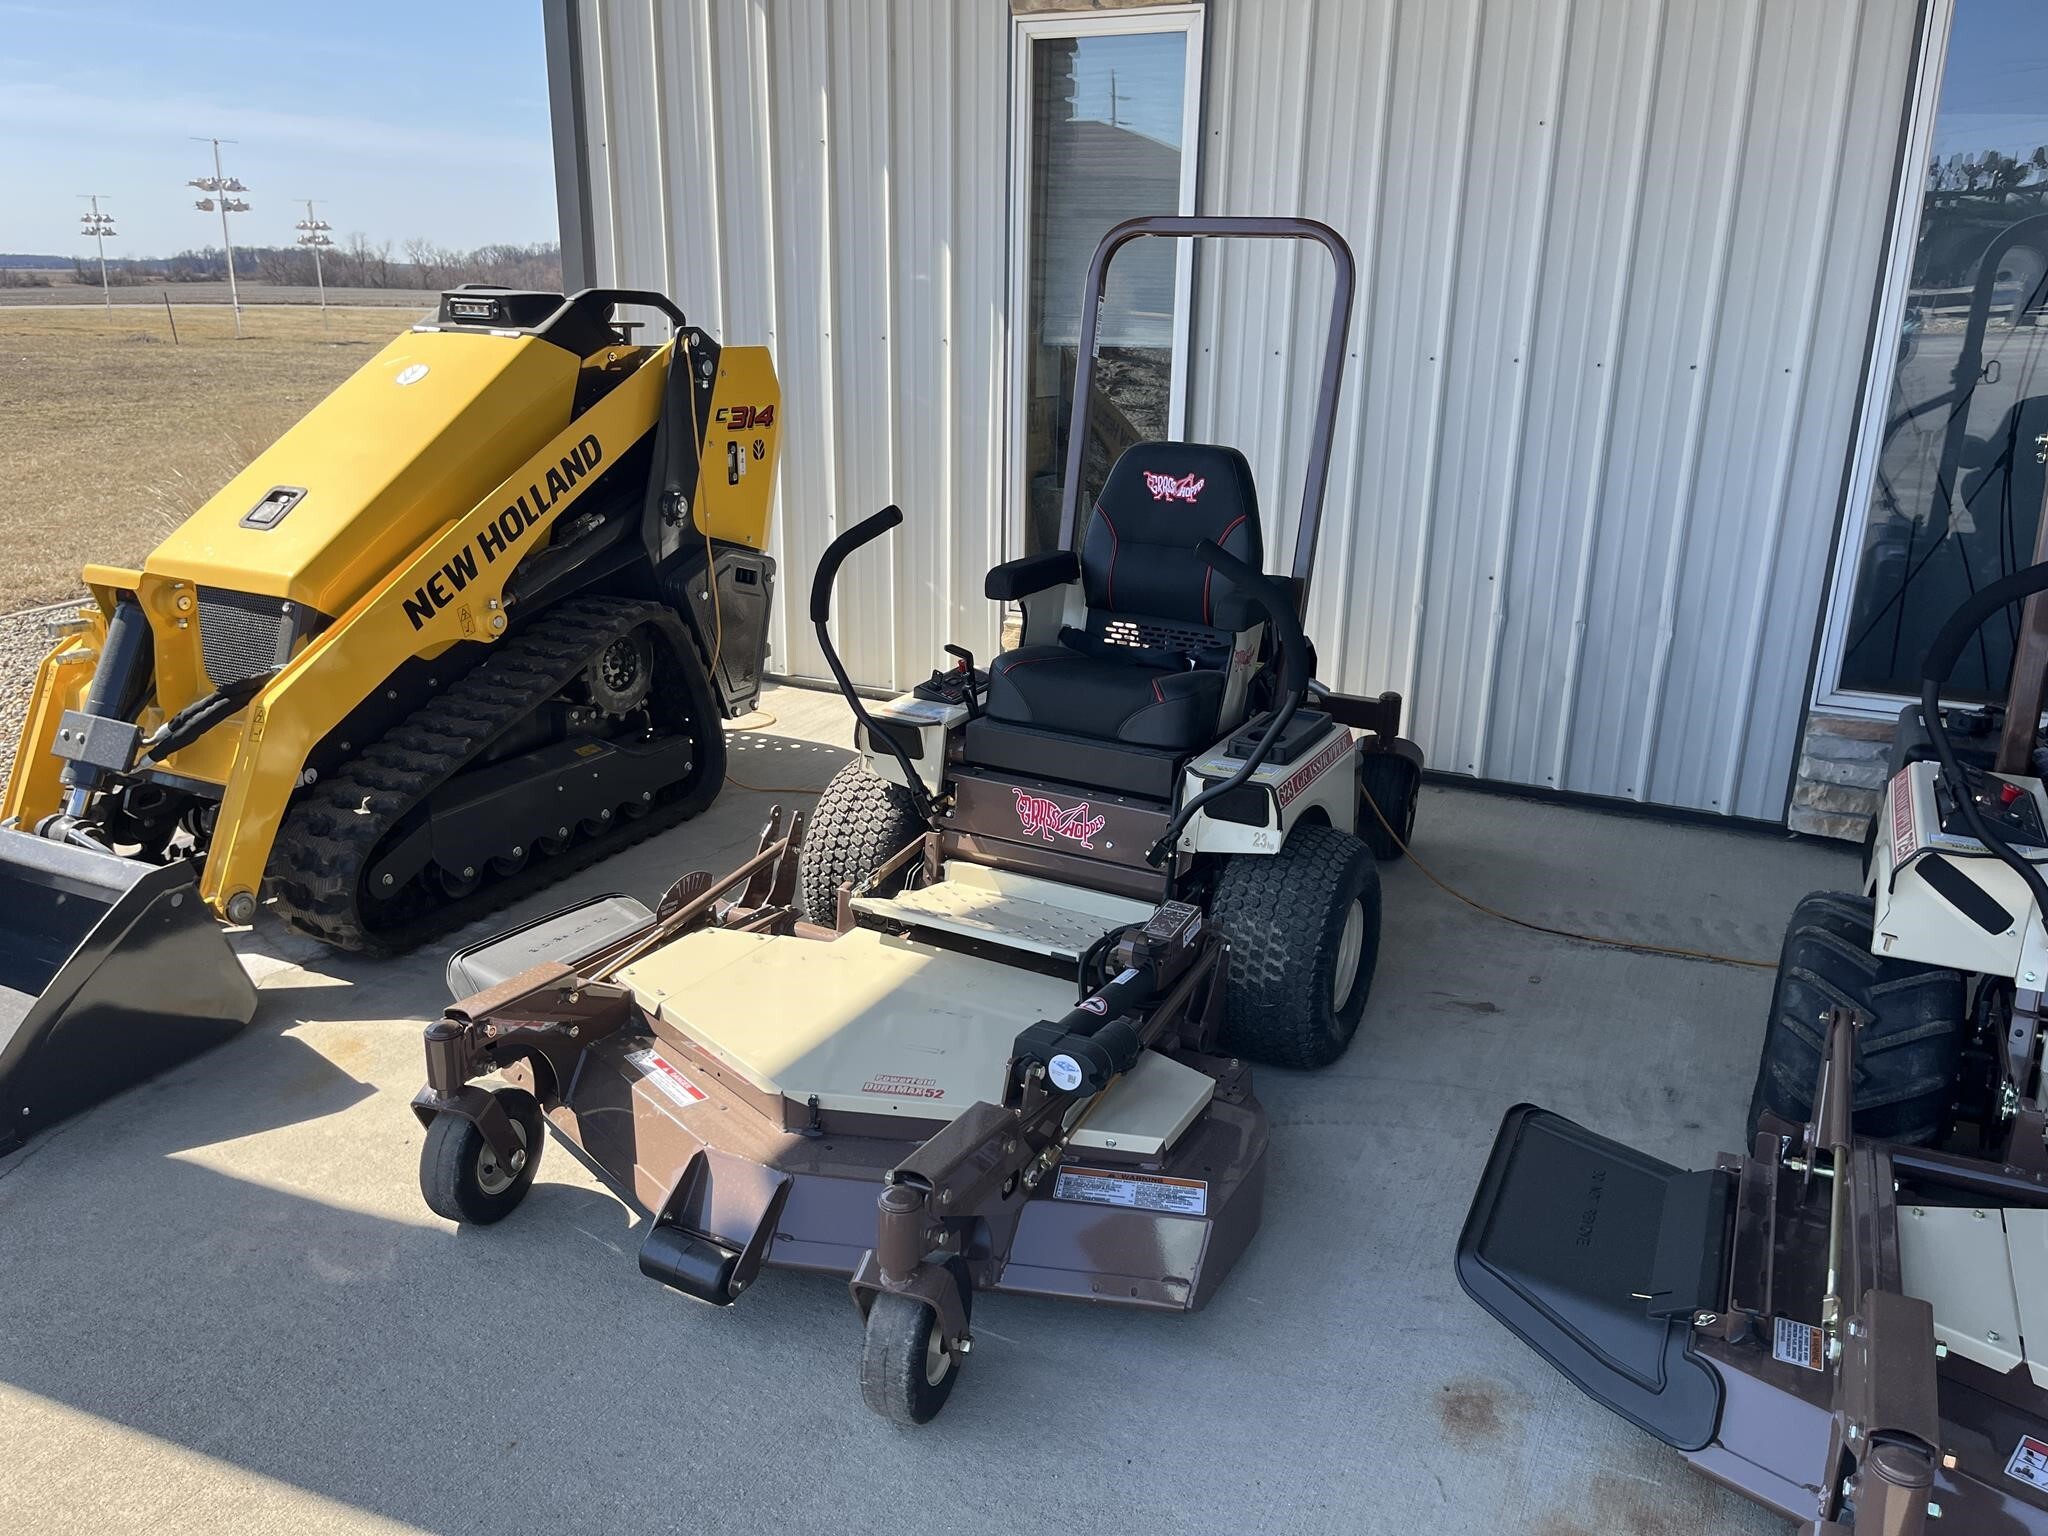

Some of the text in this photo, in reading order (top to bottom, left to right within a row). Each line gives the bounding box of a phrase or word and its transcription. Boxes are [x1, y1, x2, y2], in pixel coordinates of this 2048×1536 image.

[402, 434, 603, 631] NEW HOLLAND
[1278, 781, 1294, 806] 623
[1296, 736, 1348, 789] GRASSHOPPER
